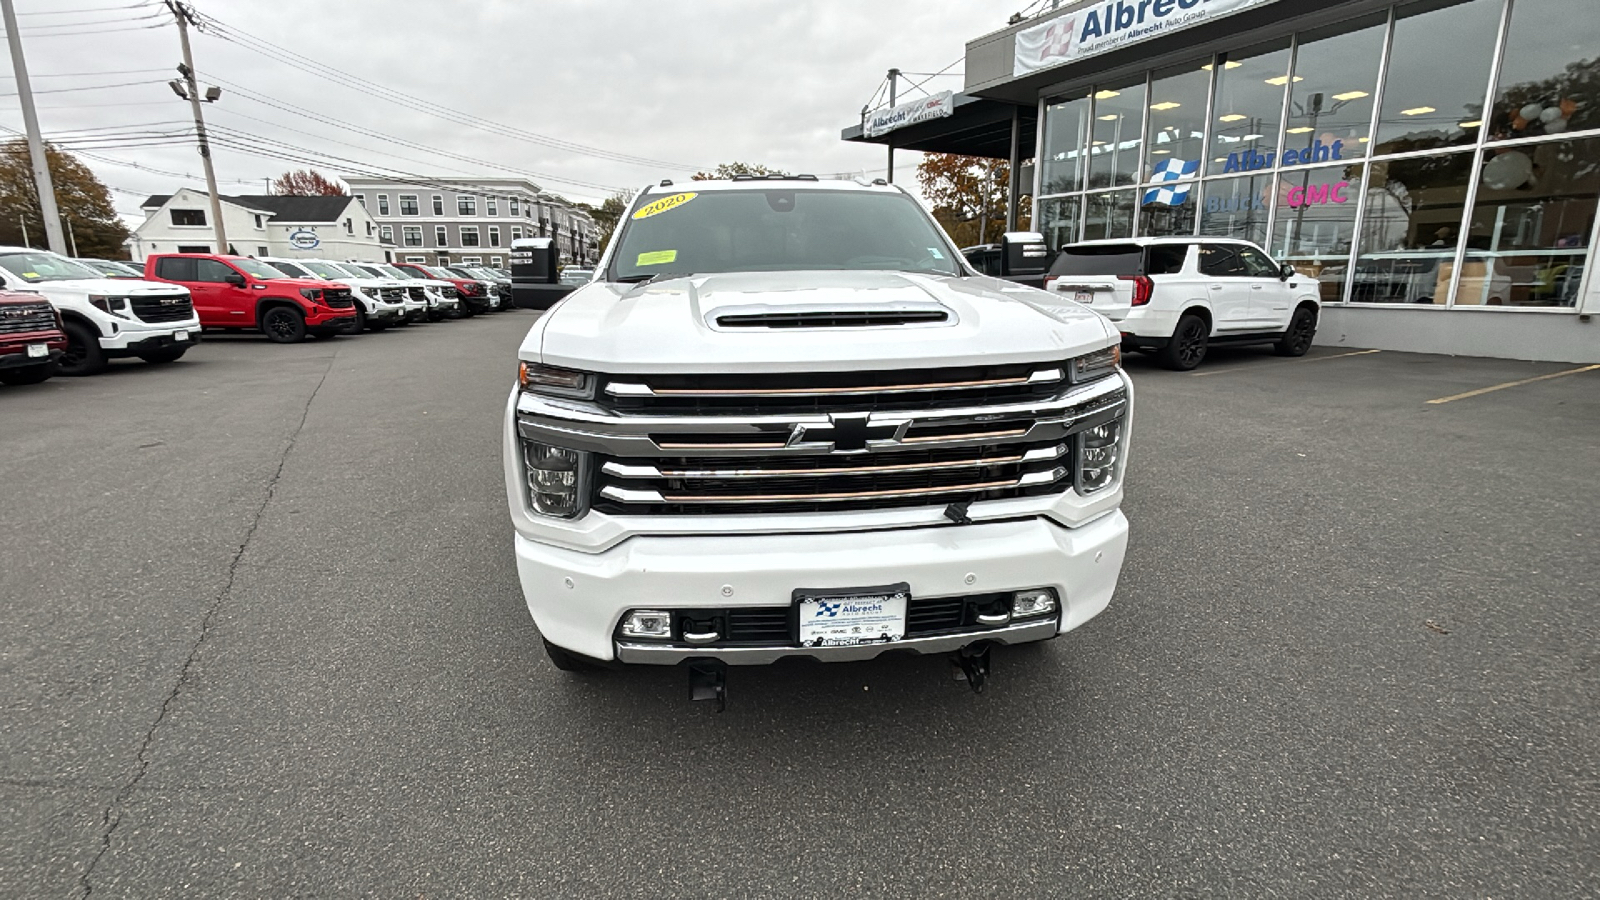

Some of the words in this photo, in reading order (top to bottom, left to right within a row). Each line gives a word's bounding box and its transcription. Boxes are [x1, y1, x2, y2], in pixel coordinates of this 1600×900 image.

[1077, 43, 1094, 54] Proud
[1095, 36, 1119, 50] member
[1120, 33, 1127, 42] of
[1127, 22, 1163, 39] Albrecht
[1165, 19, 1182, 28] Auto
[1183, 10, 1206, 22] Group
[1079, 0, 1210, 43] Albre
[872, 111, 906, 128] Albrecht
[1223, 138, 1344, 173] Albrecht
[644, 194, 686, 216] 2020
[1286, 181, 1350, 208] GMC
[842, 604, 883, 613] Albrecht
[821, 638, 860, 647] Albrecht
